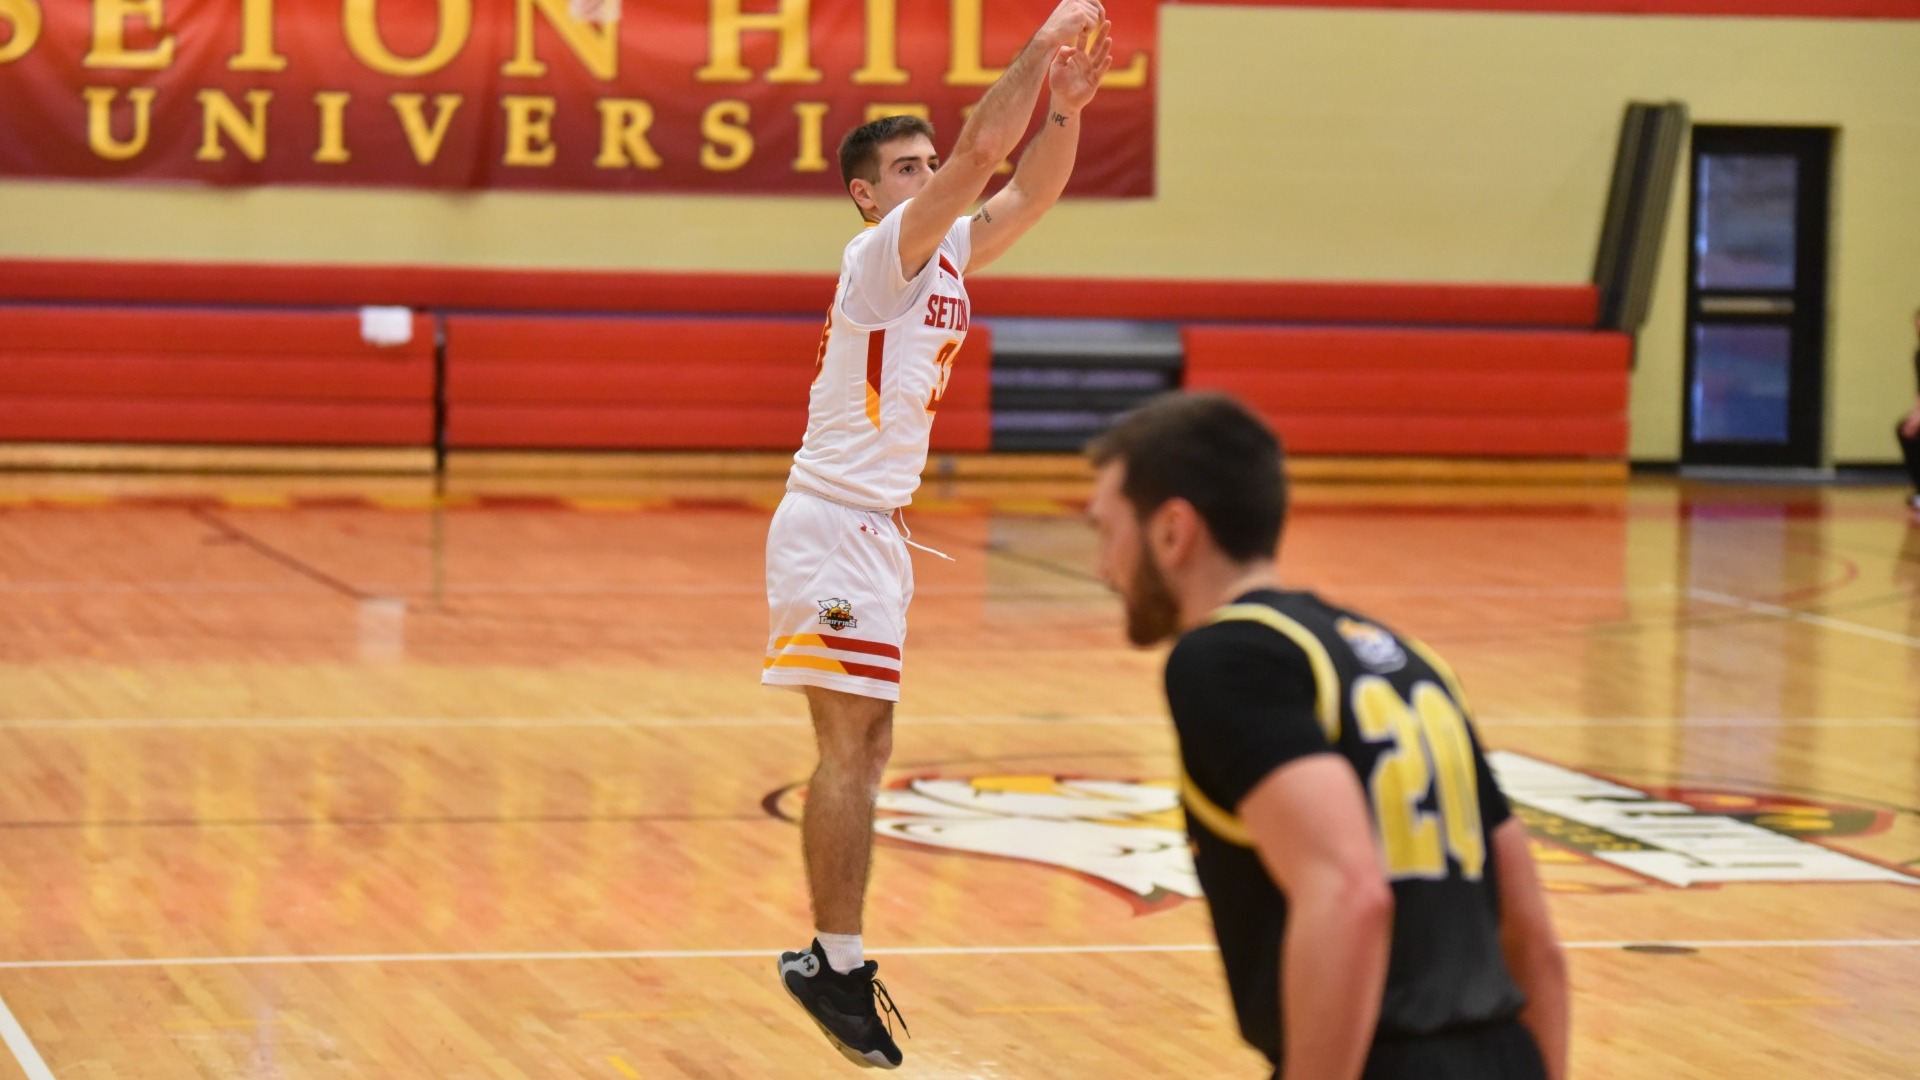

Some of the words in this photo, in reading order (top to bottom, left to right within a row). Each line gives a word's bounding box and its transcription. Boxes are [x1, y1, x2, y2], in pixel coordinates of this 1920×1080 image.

[82, 87, 1013, 174] UNIVERSI
[925, 340, 959, 415] 3
[1350, 674, 1486, 881] 20
